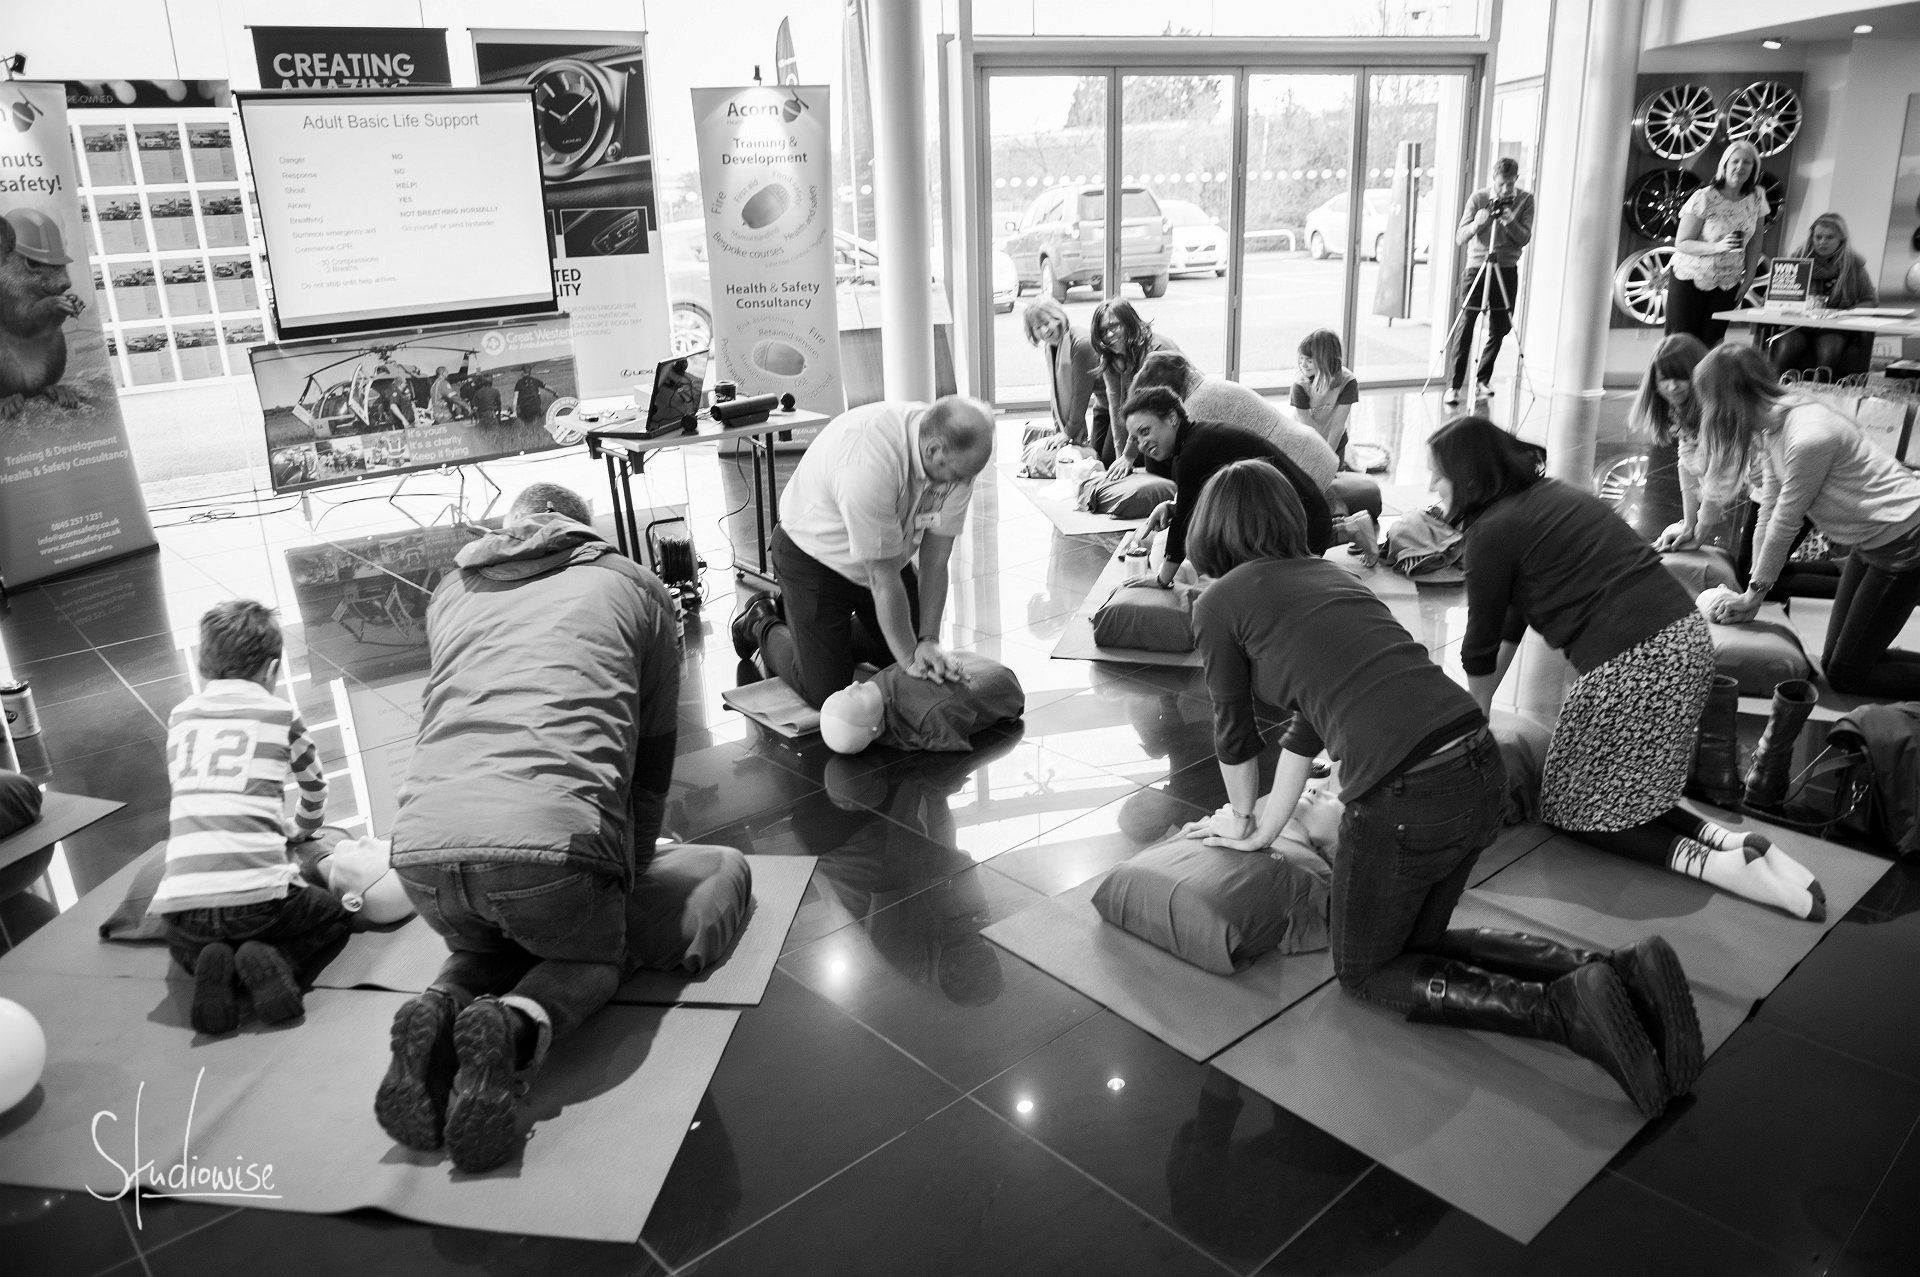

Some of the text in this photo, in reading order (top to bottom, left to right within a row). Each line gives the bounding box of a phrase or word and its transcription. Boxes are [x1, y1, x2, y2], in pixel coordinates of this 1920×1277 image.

[273, 53, 415, 77] CREATING
[727, 102, 779, 117] Acorn
[303, 112, 480, 129] Adult Basic Life Support
[733, 136, 798, 149] Training &
[2, 153, 43, 167] nuts
[722, 152, 808, 165] Development
[0, 175, 62, 195] safety!
[711, 191, 727, 214] Fire
[400, 210, 416, 218] NOT
[713, 231, 748, 257] Bespoke
[749, 246, 785, 259] courses
[555, 283, 581, 297] ITY
[726, 281, 820, 295] Health & Safety
[736, 297, 812, 309] Consultancy
[506, 328, 573, 344] Great Western
[423, 426, 448, 438] yours
[434, 435, 462, 447] charity
[5, 436, 117, 467] Training & Development
[411, 452, 436, 461] Keep
[445, 446, 469, 458] flying
[0, 449, 129, 484] Health & Safety Consultancy
[179, 728, 250, 777] 12
